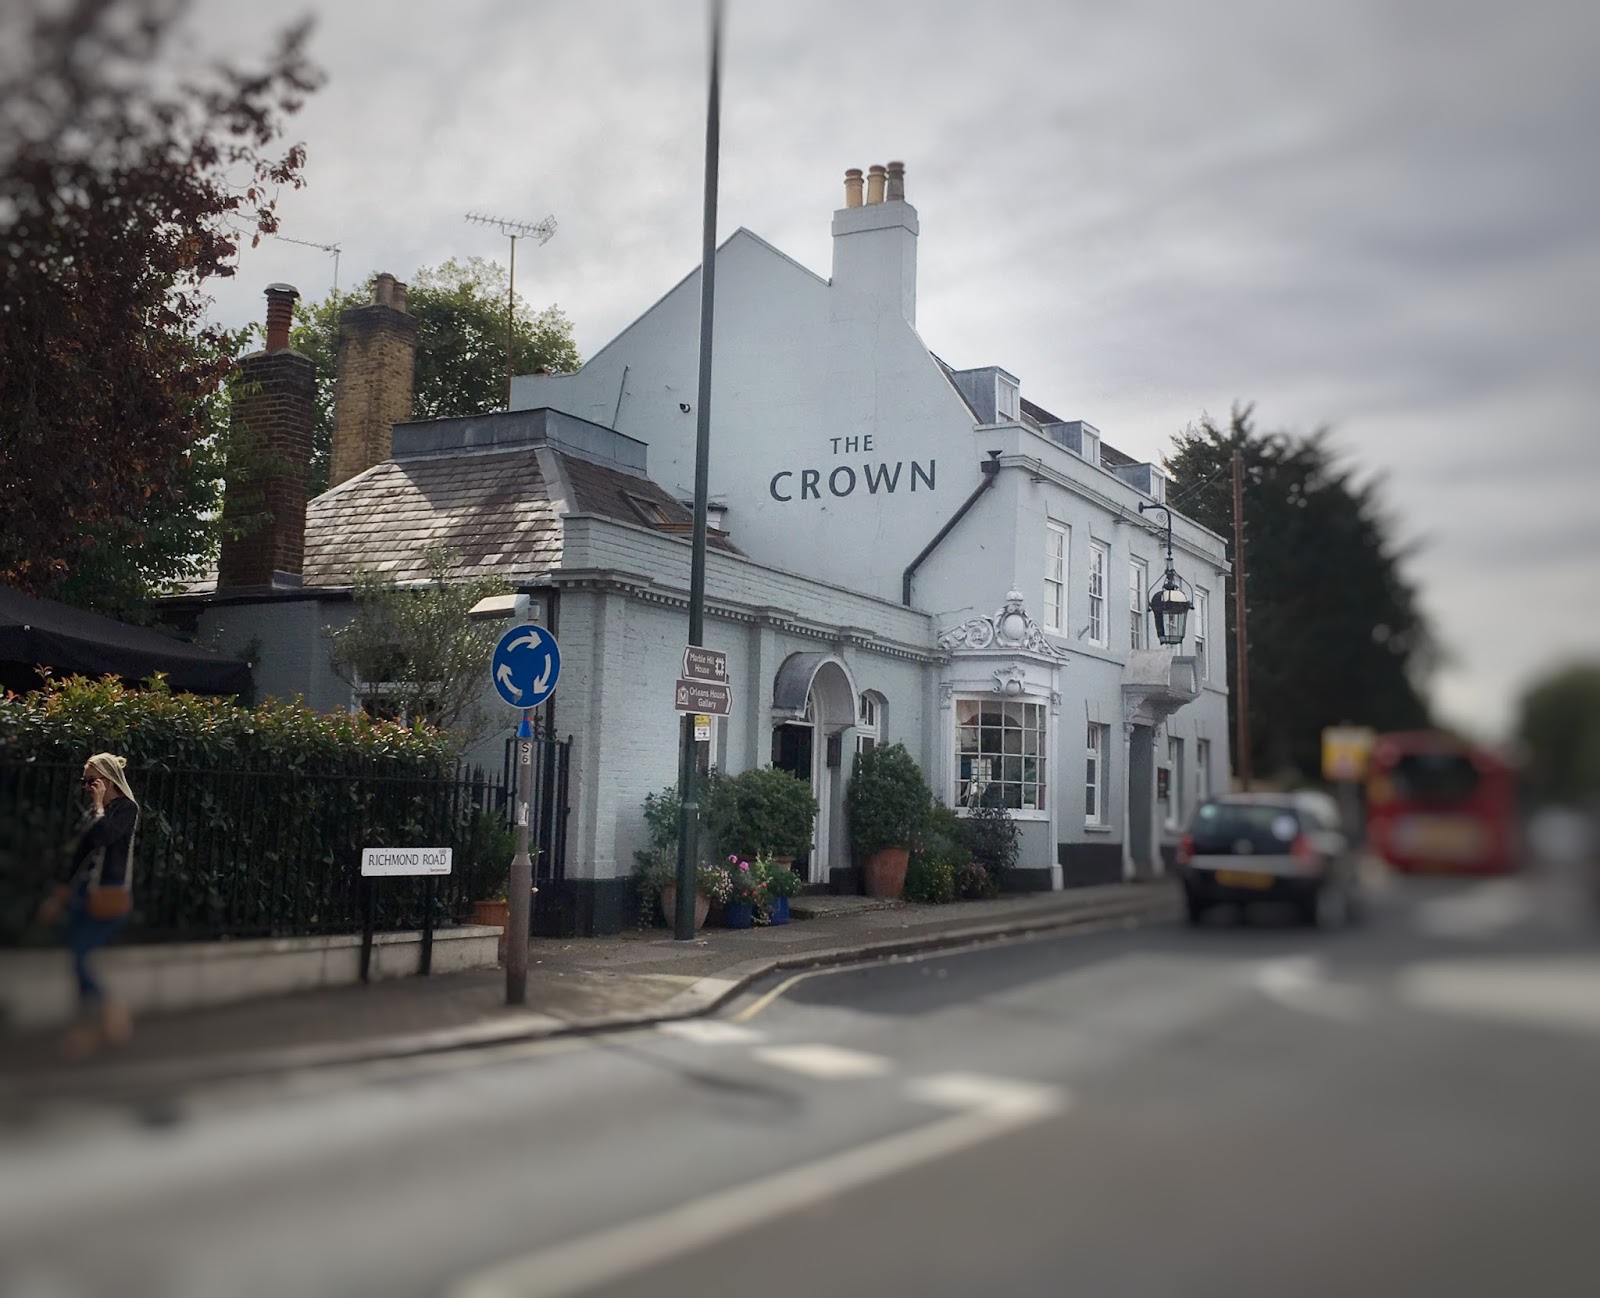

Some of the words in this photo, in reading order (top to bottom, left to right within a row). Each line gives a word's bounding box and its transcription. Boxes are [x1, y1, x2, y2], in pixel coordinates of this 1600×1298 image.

[829, 434, 874, 455] THE
[769, 459, 936, 502] CROWN
[689, 652, 706, 664] Marble
[694, 664, 710, 674] House
[689, 686, 709, 698] Orleans
[710, 689, 726, 699] House
[698, 697, 717, 710] Gallery
[521, 742, 529, 753] S
[522, 754, 529, 763] 6
[368, 853, 419, 866] RICHMOND
[422, 853, 447, 866] ROAD
